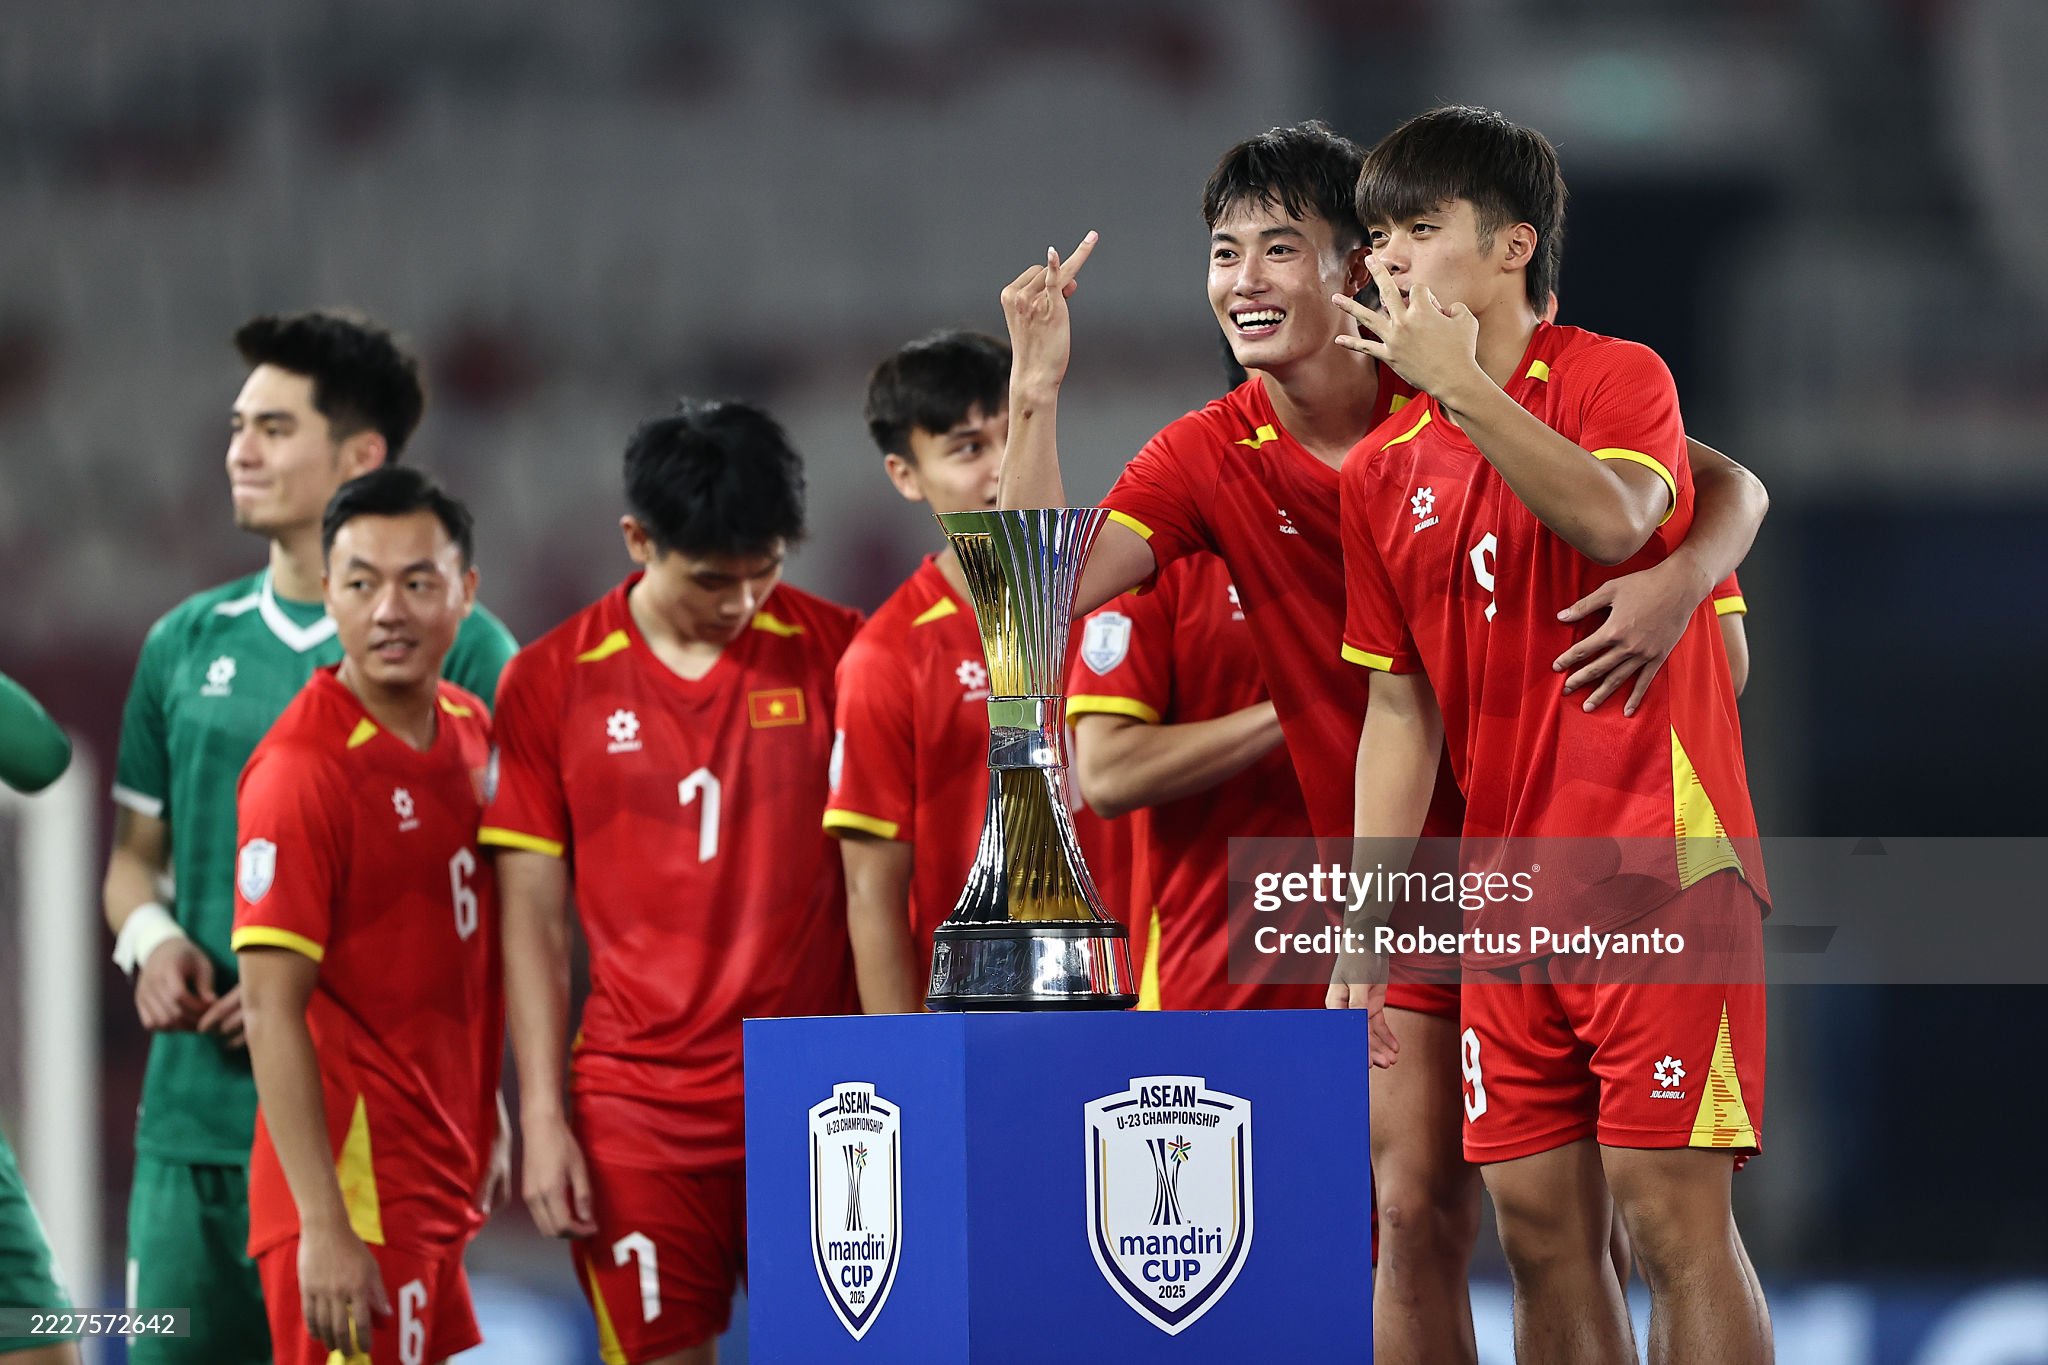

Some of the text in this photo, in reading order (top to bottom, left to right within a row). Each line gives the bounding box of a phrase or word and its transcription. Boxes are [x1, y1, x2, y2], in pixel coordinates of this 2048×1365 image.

[678, 766, 721, 864] 7
[448, 847, 478, 942] 6
[1461, 1026, 1487, 1124] 9
[838, 1091, 870, 1115] ASEAN
[1139, 1085, 1196, 1109] ASEAN
[826, 1117, 884, 1136] U-23 CHAMPIONSHIP
[1116, 1111, 1220, 1130] U-23 CHAMPIONSHIP
[828, 1232, 885, 1261] mandiri
[1119, 1226, 1222, 1256] mandiri
[612, 1231, 662, 1323] 7
[841, 1265, 873, 1288] CUP
[1142, 1259, 1201, 1283] CUP
[849, 1290, 865, 1305] 2025
[1158, 1284, 1186, 1299] 2025
[398, 1278, 428, 1365] 6
